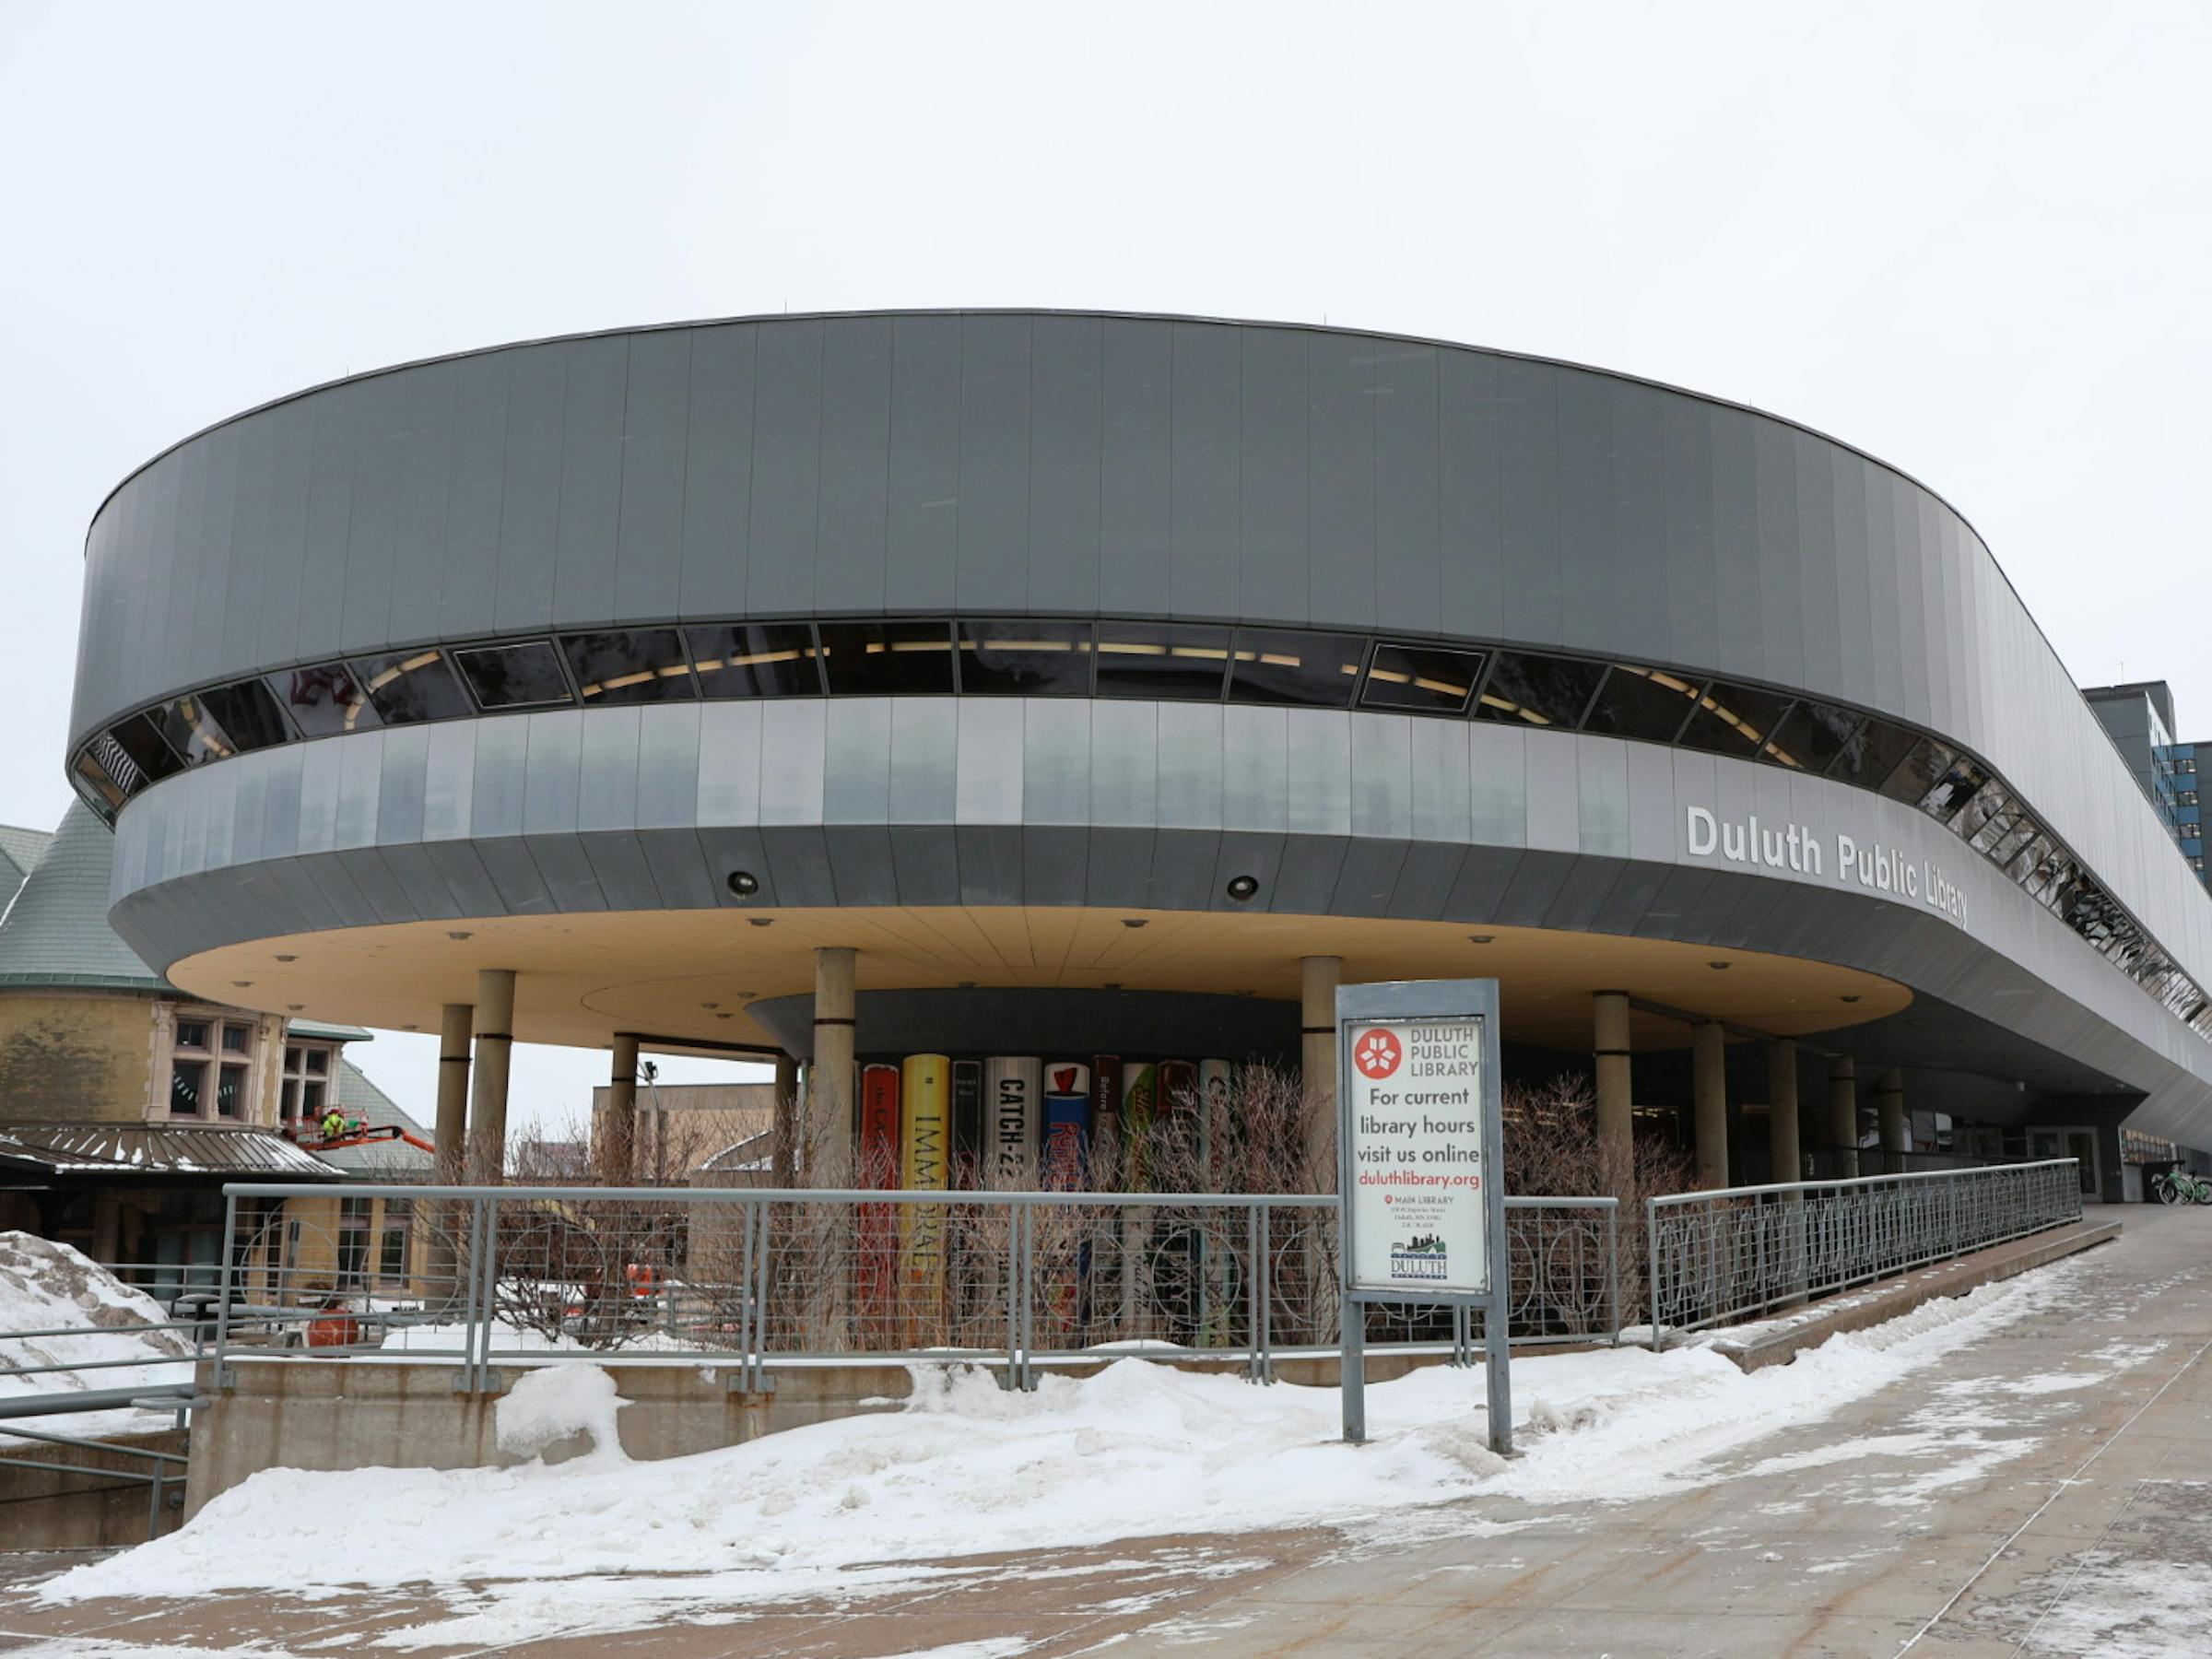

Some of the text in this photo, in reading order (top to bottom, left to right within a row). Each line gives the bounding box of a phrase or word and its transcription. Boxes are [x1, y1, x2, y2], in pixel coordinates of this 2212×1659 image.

[1687, 806, 1968, 931] Duluth Public Library
[1411, 1027, 1474, 1043] DULUTH
[1411, 1044, 1468, 1059] PUBLIC
[1410, 1061, 1478, 1077] LIBRARY
[1370, 1088, 1469, 1106] For current
[1360, 1115, 1475, 1138] library hours
[1358, 1144, 1480, 1163] visit us online
[1359, 1171, 1480, 1189] duluthlibrary.org
[1418, 1196, 1454, 1205] LIBRARY
[1392, 1259, 1447, 1274] DULUTH
